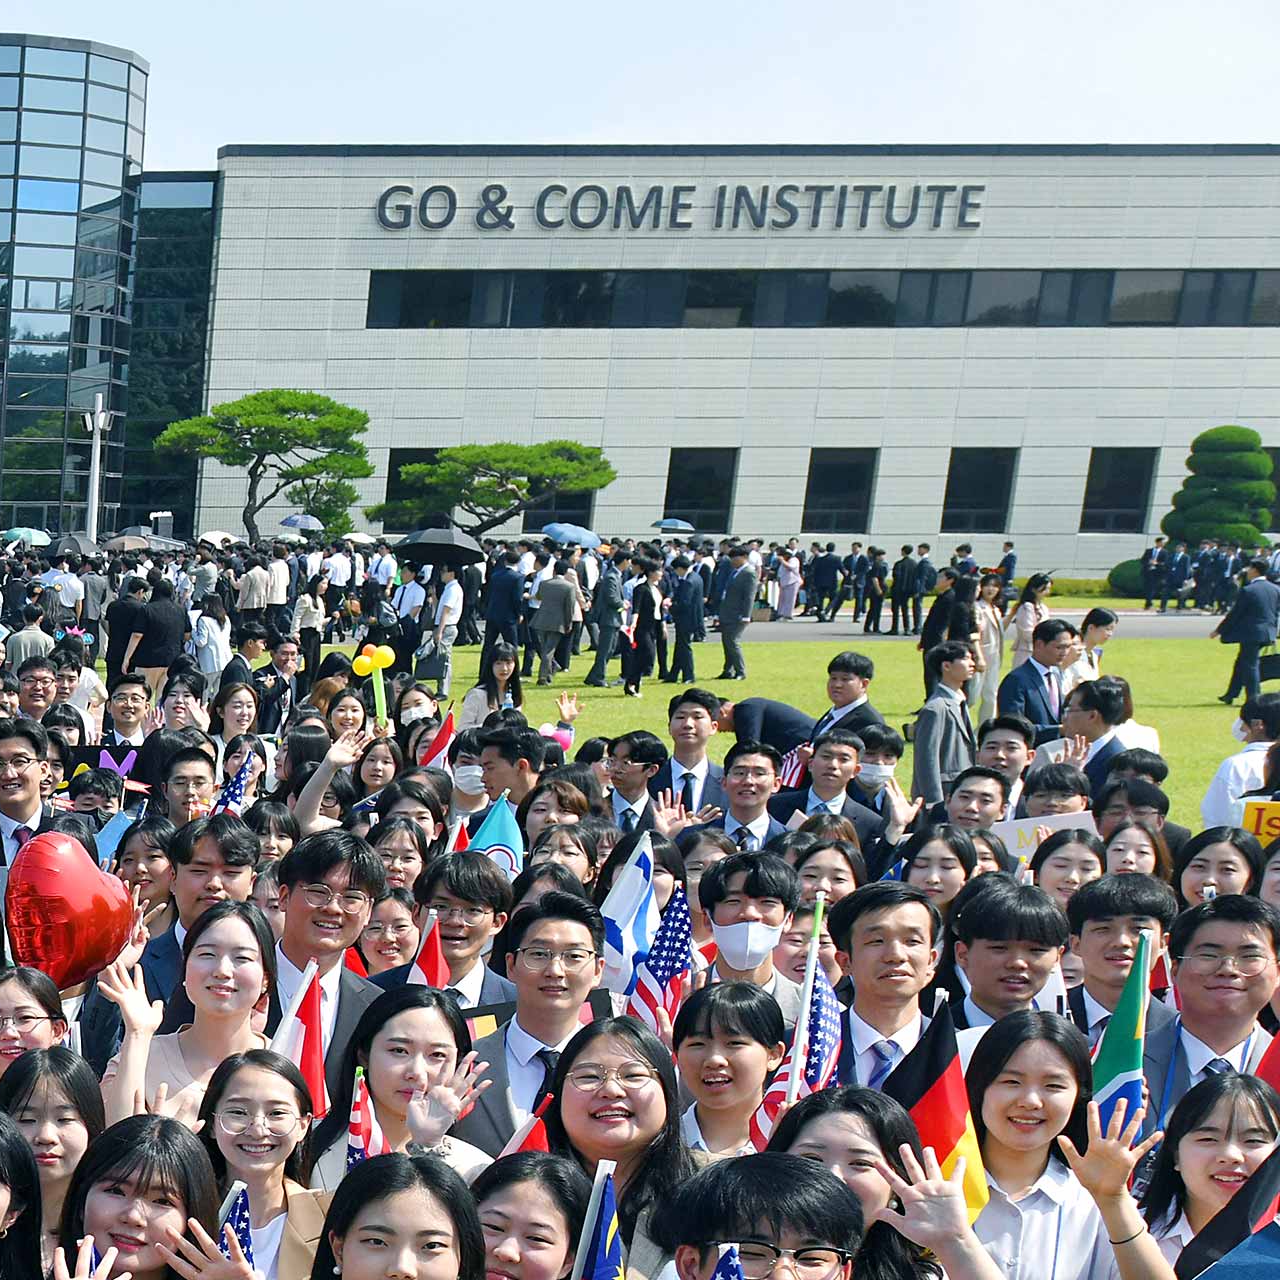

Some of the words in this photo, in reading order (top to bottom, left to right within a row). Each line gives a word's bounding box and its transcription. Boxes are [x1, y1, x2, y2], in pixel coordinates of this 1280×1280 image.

[376, 184, 459, 231] GO
[474, 183, 516, 231] &
[535, 184, 697, 231] COME
[712, 183, 987, 231] INSTITUTE
